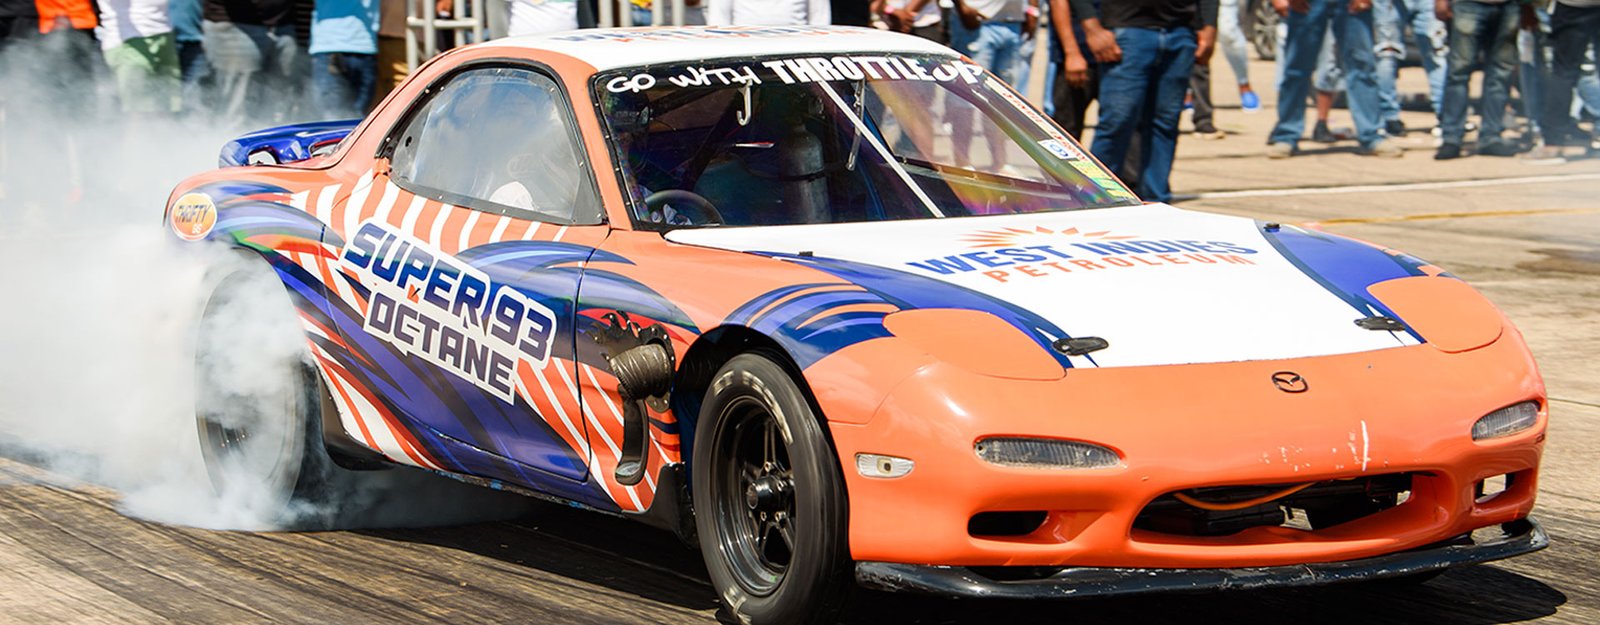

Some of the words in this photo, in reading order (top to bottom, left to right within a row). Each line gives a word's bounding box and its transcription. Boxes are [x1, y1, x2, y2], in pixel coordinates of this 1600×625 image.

[606, 73, 656, 93] GO
[905, 245, 1074, 275] WEST
[1070, 239, 1259, 256] INDIES
[982, 253, 1257, 283] PETROLEUM
[344, 222, 487, 329] SUPER
[491, 293, 553, 362] 93
[368, 292, 514, 396] OCTANE
